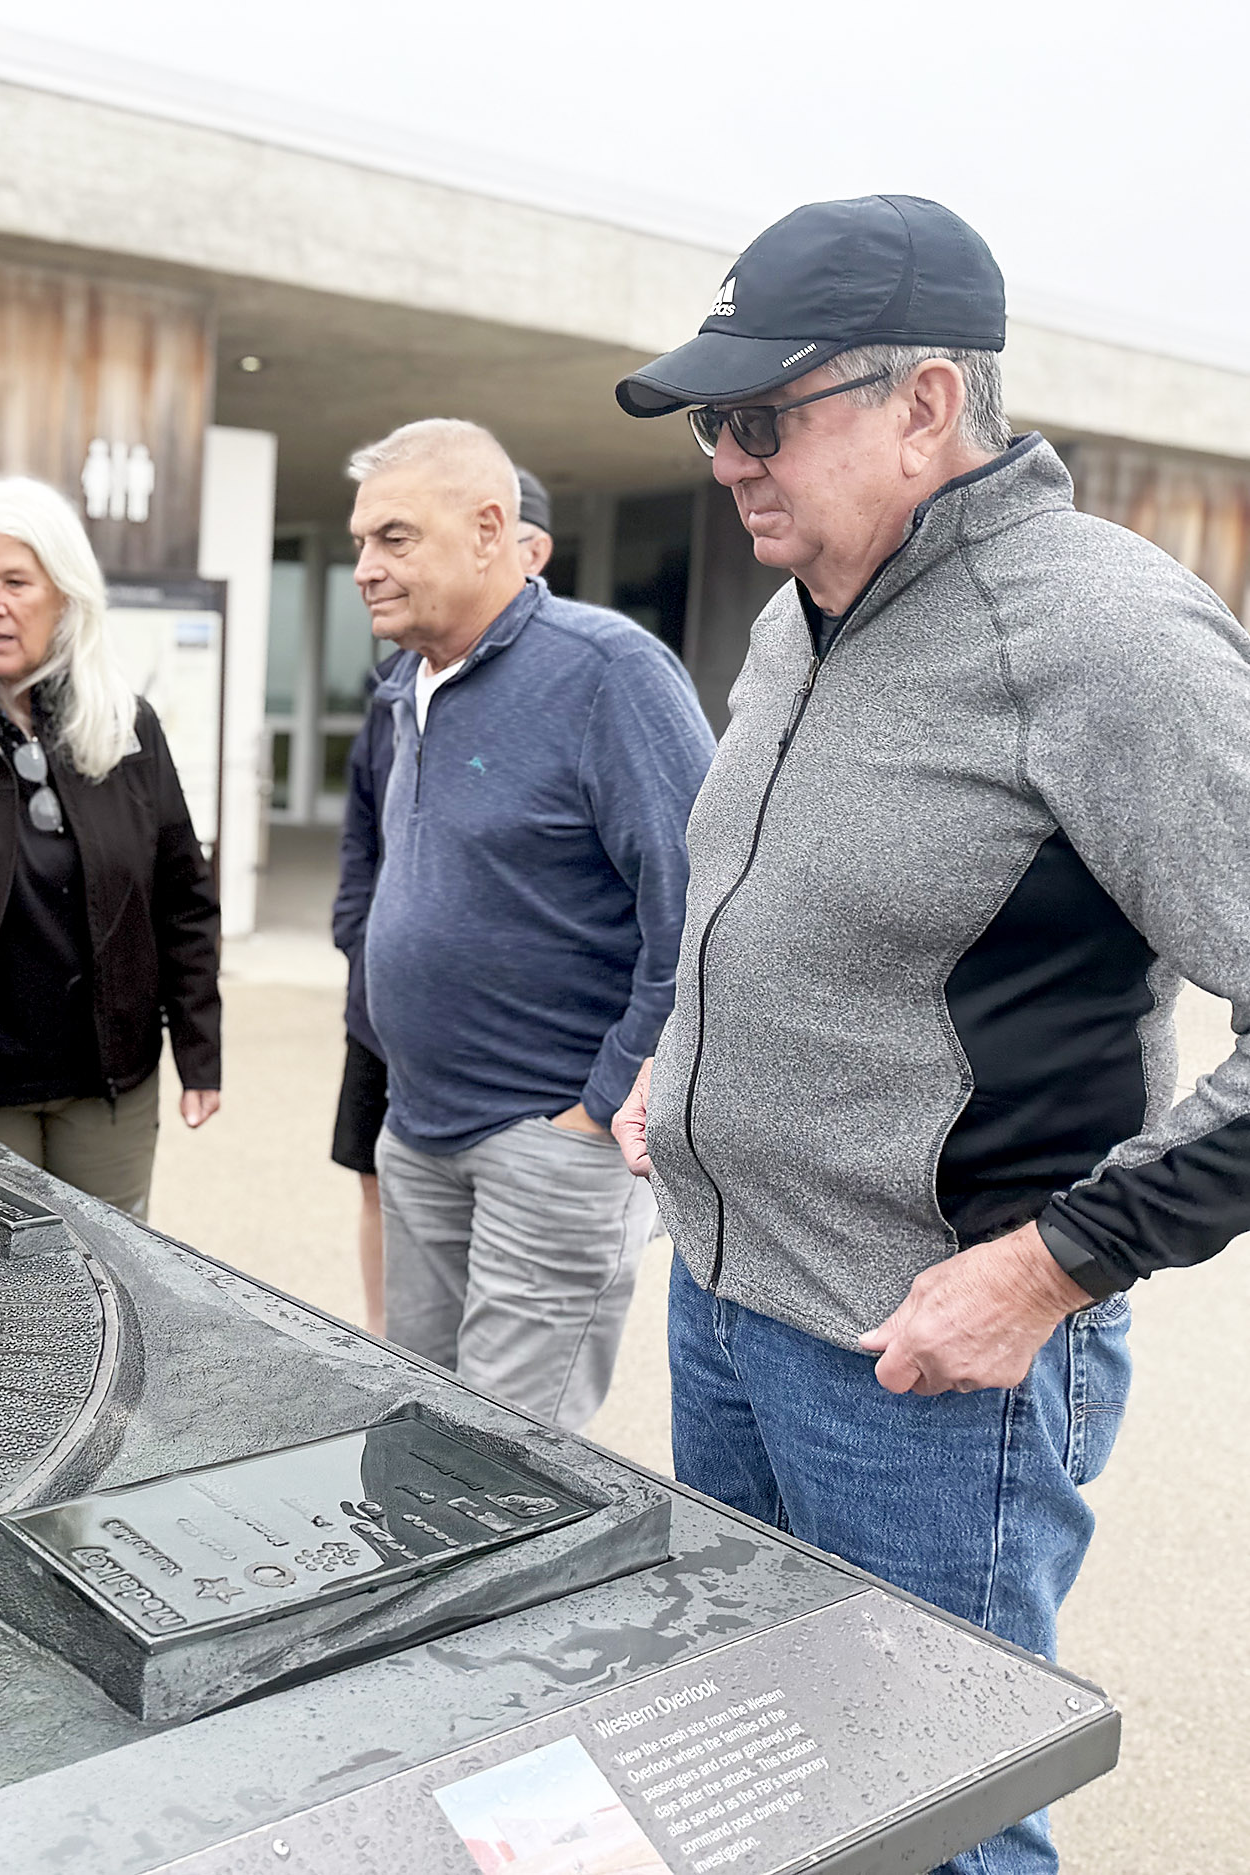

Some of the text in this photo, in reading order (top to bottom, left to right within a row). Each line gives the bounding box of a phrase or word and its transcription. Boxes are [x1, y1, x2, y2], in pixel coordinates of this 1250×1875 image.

[72, 1546, 187, 1628] Model Key
[594, 1679, 719, 1738] Western Overlook
[614, 1690, 784, 1765] View the crash site from the Western
[628, 1710, 787, 1783] Overlook where the families of the
[642, 1723, 804, 1803] passengers and crew gathered just
[654, 1739, 816, 1818] days after the attack. This location
[667, 1757, 828, 1837] also served as the FBI's temporary
[681, 1791, 803, 1854] command post during the
[692, 1837, 759, 1872] investigation.
